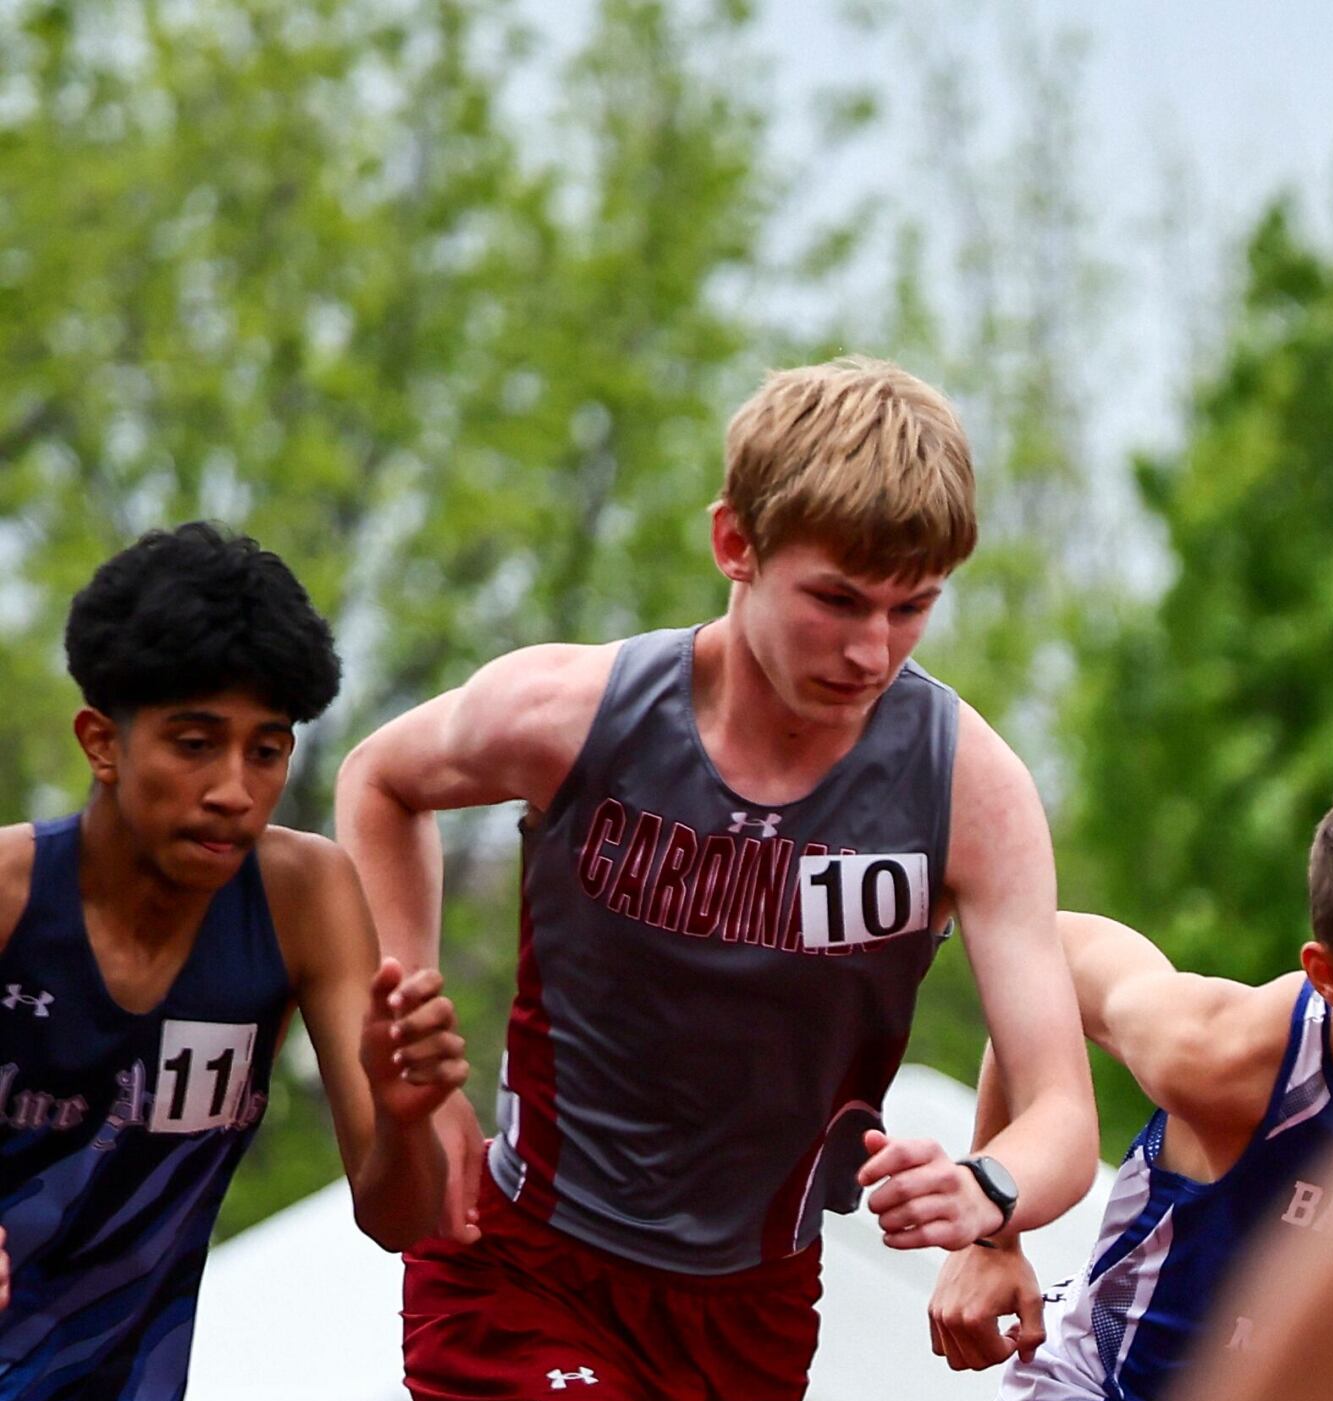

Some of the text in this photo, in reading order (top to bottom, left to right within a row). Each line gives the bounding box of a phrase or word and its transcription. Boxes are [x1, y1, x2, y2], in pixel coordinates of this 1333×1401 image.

[579, 798, 882, 956] CARDIN
[810, 859, 911, 942] 10
[164, 1048, 235, 1120] 11
